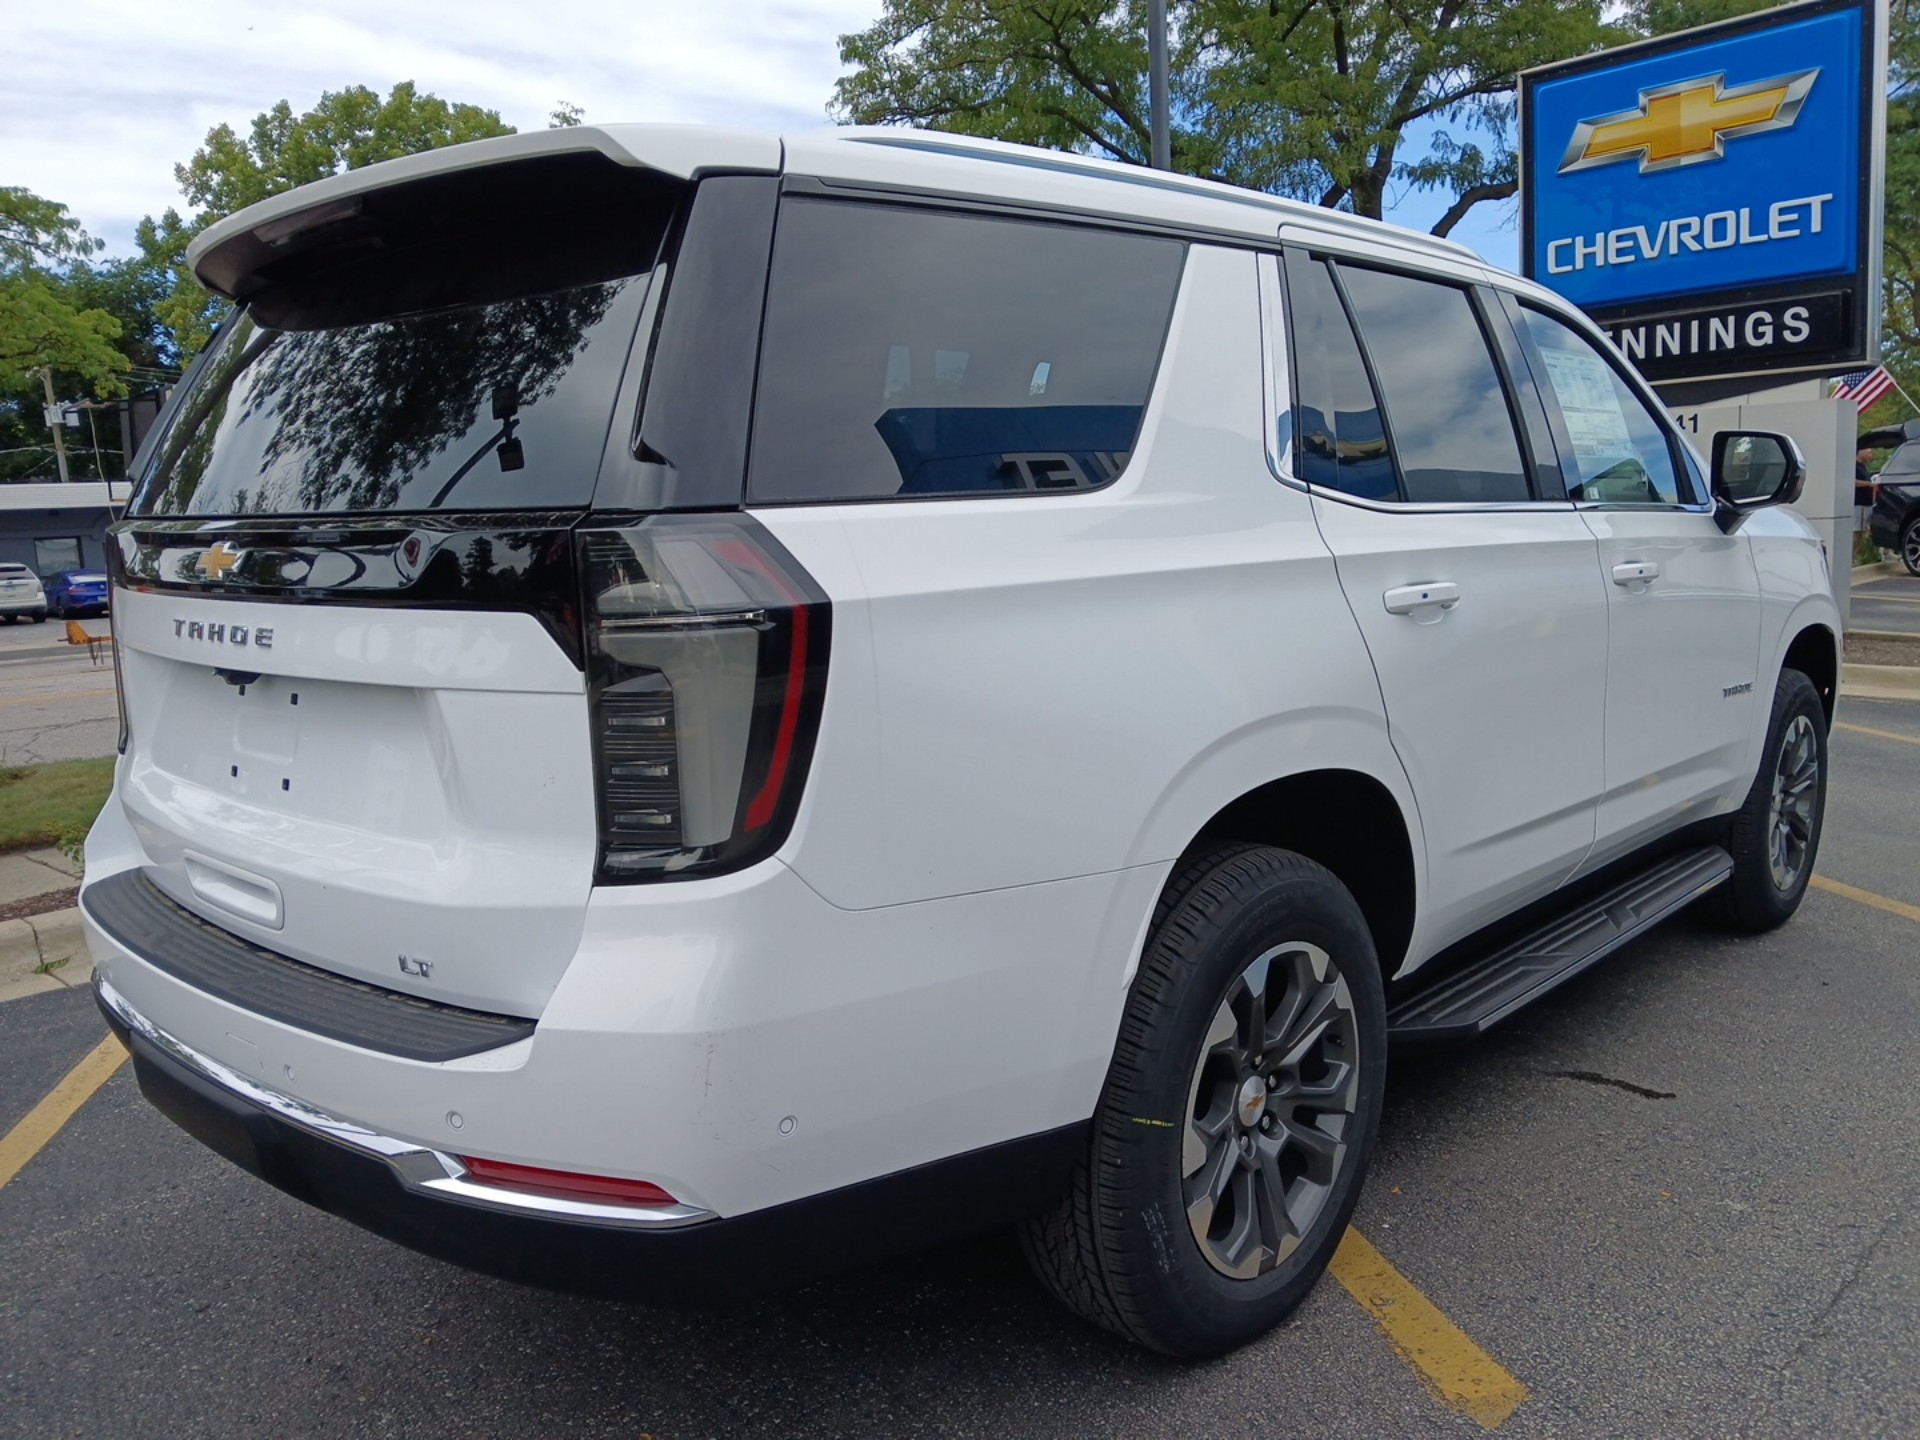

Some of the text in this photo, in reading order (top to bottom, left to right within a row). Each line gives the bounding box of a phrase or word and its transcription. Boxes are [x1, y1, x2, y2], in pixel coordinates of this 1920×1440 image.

[1547, 193, 1834, 274] CHEVROLET
[1604, 306, 1811, 360] NNINGS
[173, 618, 274, 649] TAHOE
[398, 954, 433, 978] LT
